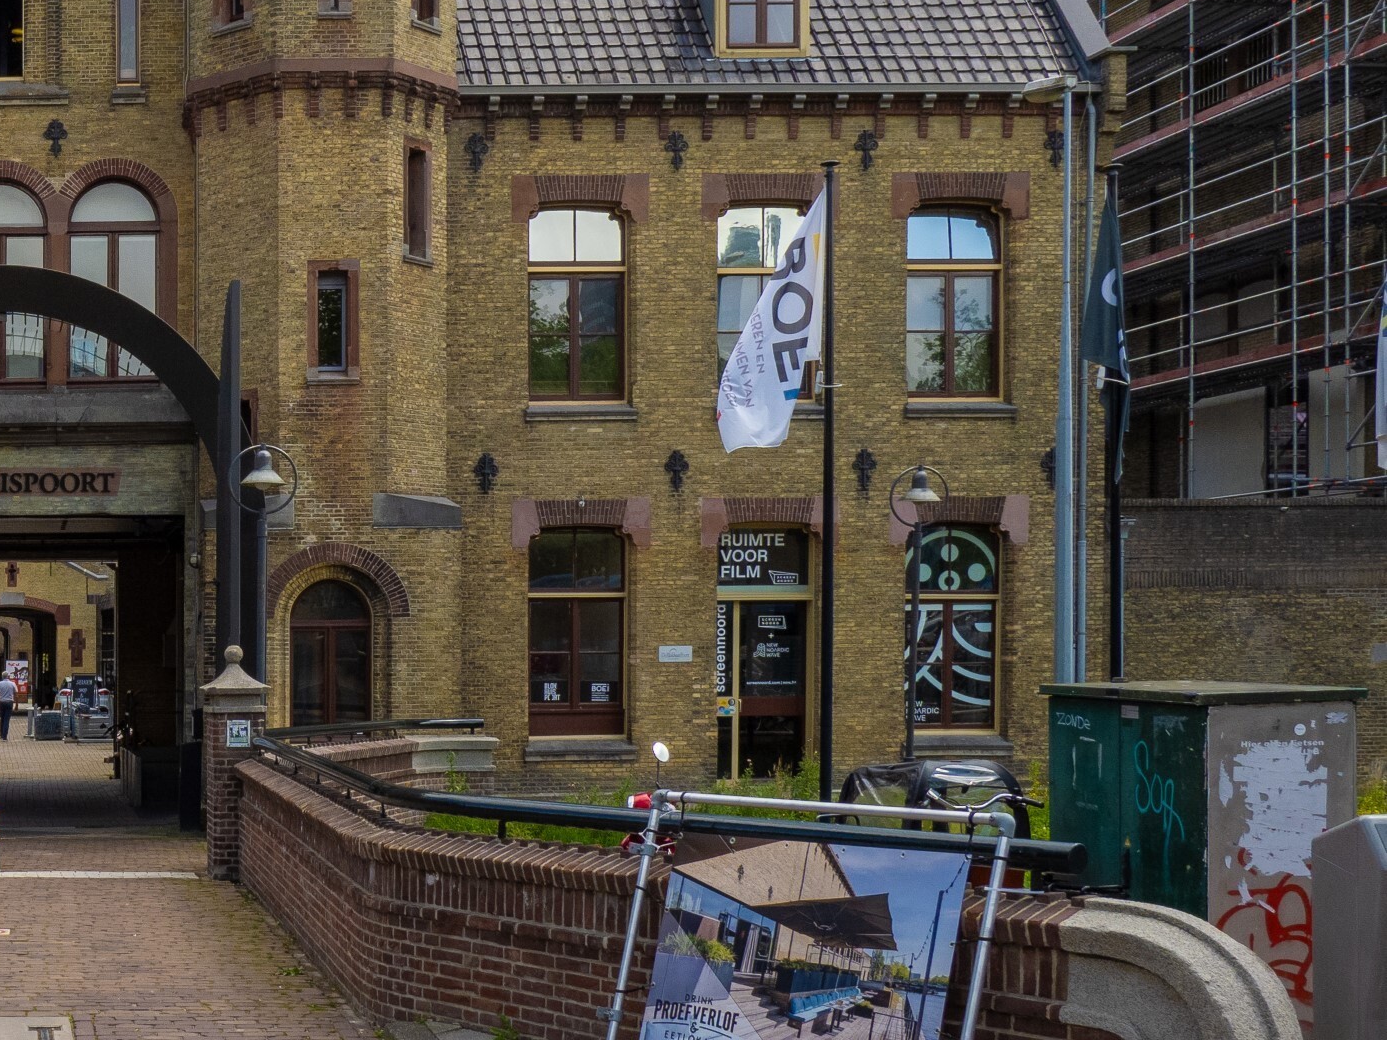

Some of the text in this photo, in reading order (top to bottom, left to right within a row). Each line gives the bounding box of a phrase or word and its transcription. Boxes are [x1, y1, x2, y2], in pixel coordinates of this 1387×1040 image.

[743, 379, 755, 408] VAN
[721, 533, 785, 546] RUIMTE
[720, 549, 768, 562] VOOR
[720, 565, 760, 578] FILM
[716, 604, 726, 692] screennoord
[685, 993, 713, 1005] DRINK
[653, 999, 740, 1033] PROEFVERLOF
